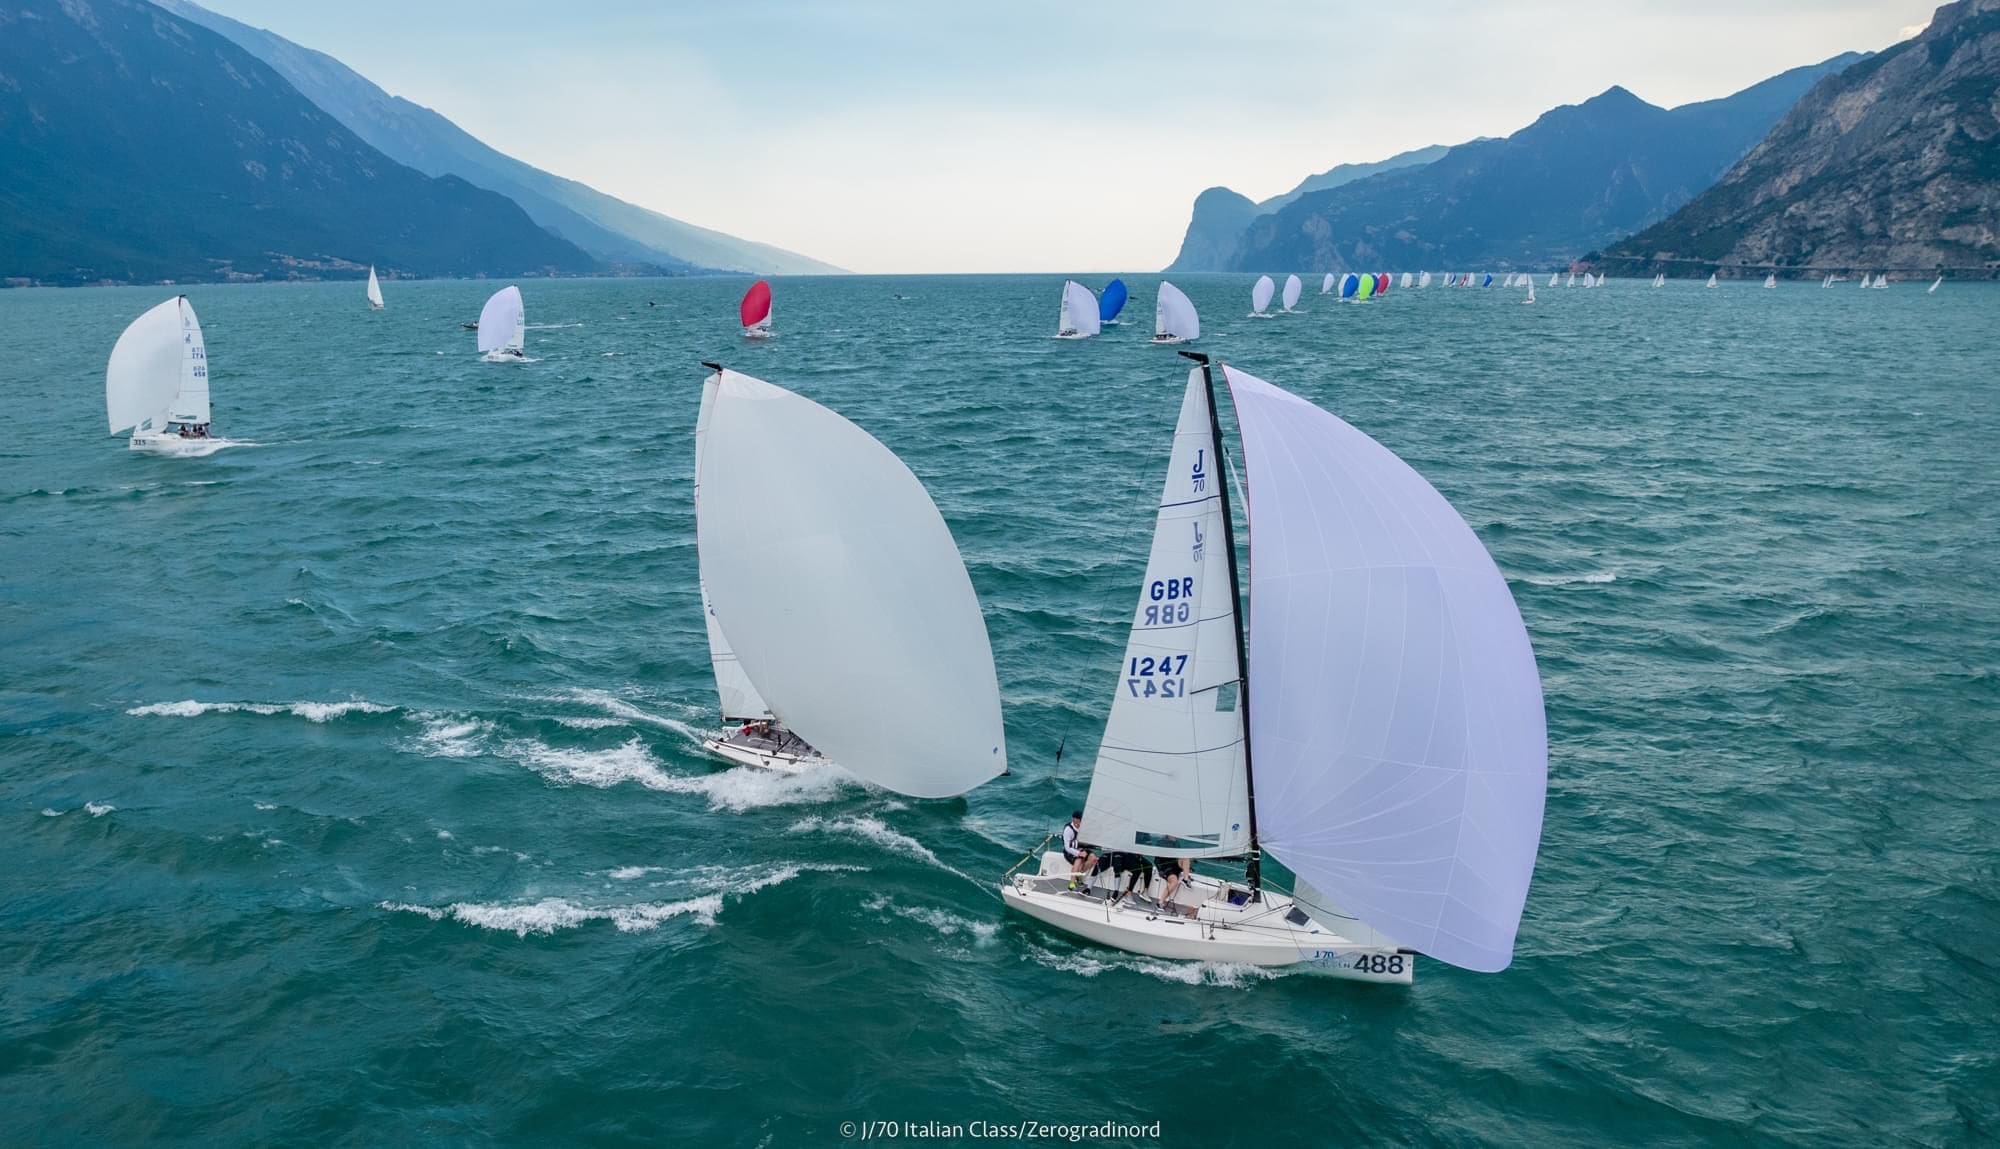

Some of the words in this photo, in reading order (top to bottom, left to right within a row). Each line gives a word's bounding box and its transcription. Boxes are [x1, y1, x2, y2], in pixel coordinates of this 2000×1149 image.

[1192, 449, 1204, 473] J
[1193, 478, 1205, 494] 70
[1150, 577, 1193, 602] GBR
[1130, 654, 1188, 677] 1247
[1353, 954, 1404, 975] 488
